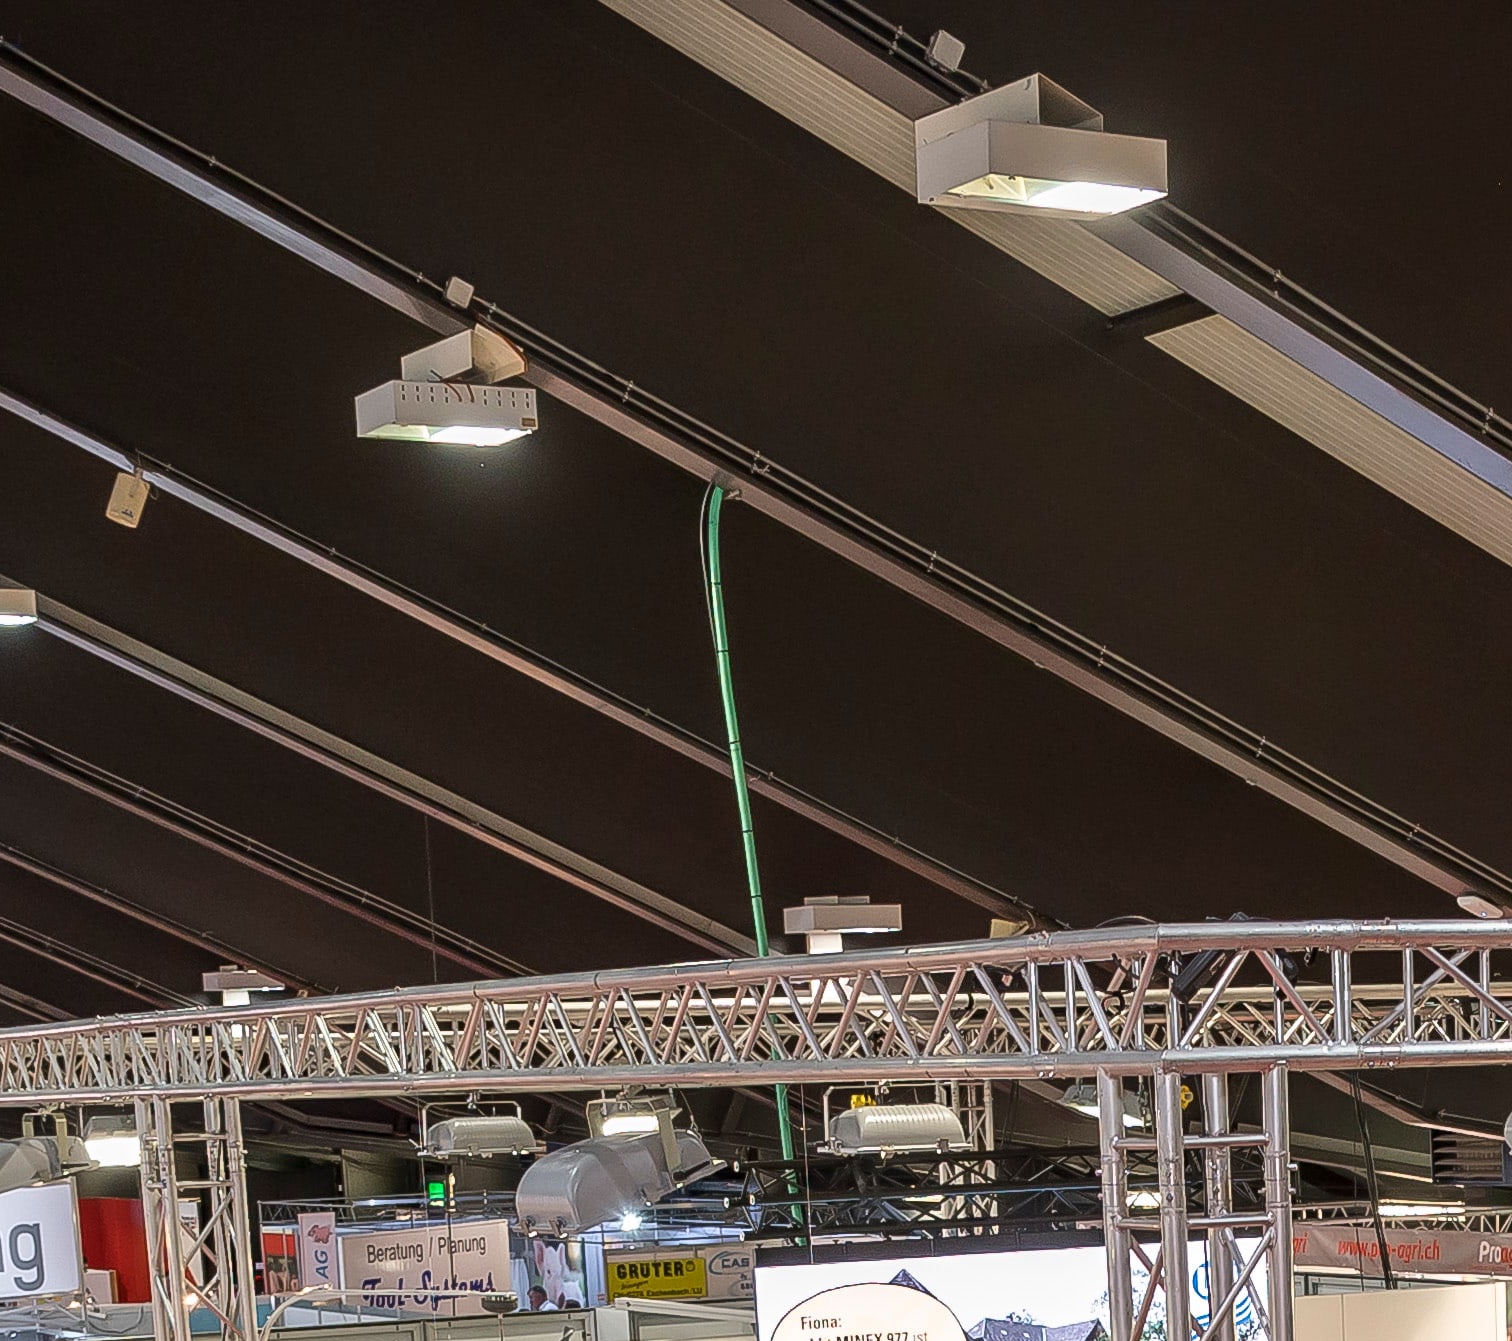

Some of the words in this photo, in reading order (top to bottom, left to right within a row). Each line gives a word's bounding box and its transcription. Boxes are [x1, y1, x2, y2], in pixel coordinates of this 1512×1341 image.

[367, 1243, 424, 1264] Beratung
[438, 1236, 486, 1256] Planung
[1338, 1239, 1441, 1264] www.po-agri.ch
[800, 1314, 843, 1330] Fiona:
